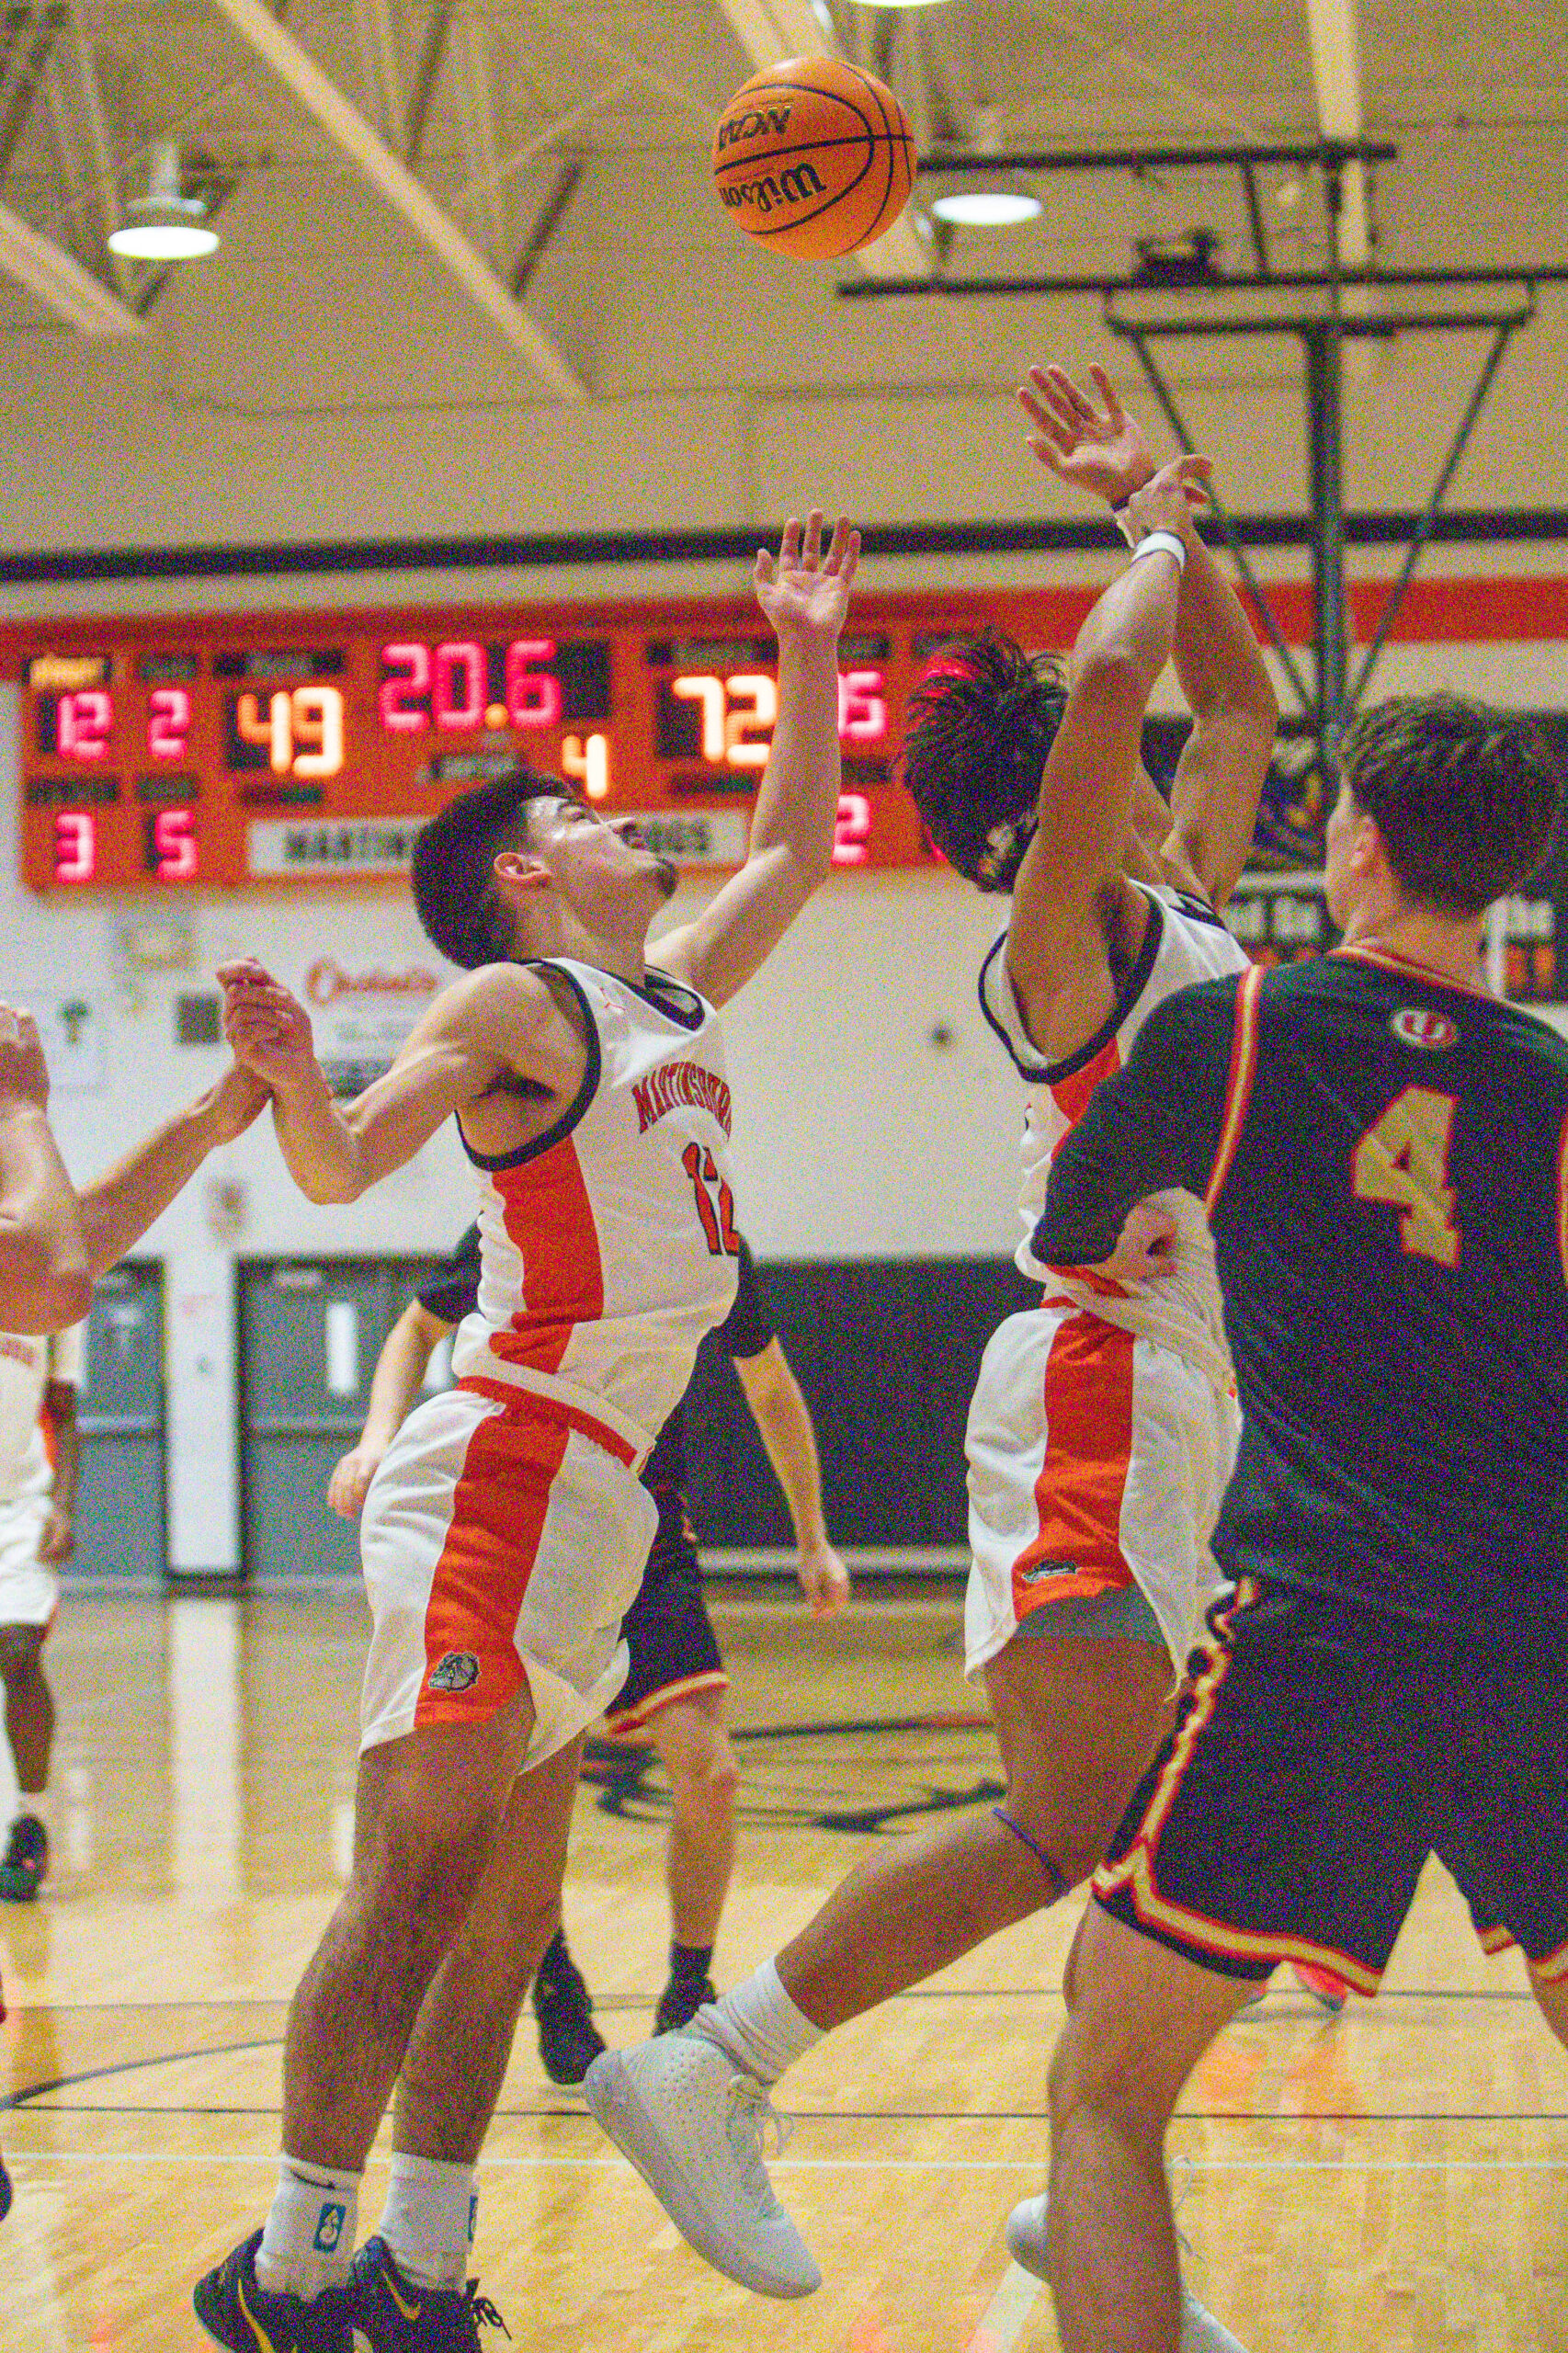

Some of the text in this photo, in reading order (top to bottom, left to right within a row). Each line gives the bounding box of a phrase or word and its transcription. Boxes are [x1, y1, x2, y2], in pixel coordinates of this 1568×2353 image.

[719, 162, 827, 212] Wilson
[379, 640, 562, 732] 20.6
[672, 674, 779, 767] 72
[149, 688, 191, 761] 2
[237, 687, 344, 778] 49
[562, 733, 608, 800] 4
[54, 813, 95, 882] 3
[154, 810, 199, 881] 5
[832, 793, 870, 865] 2
[681, 1142, 740, 1256] 12
[1353, 1084, 1461, 1270] 4
